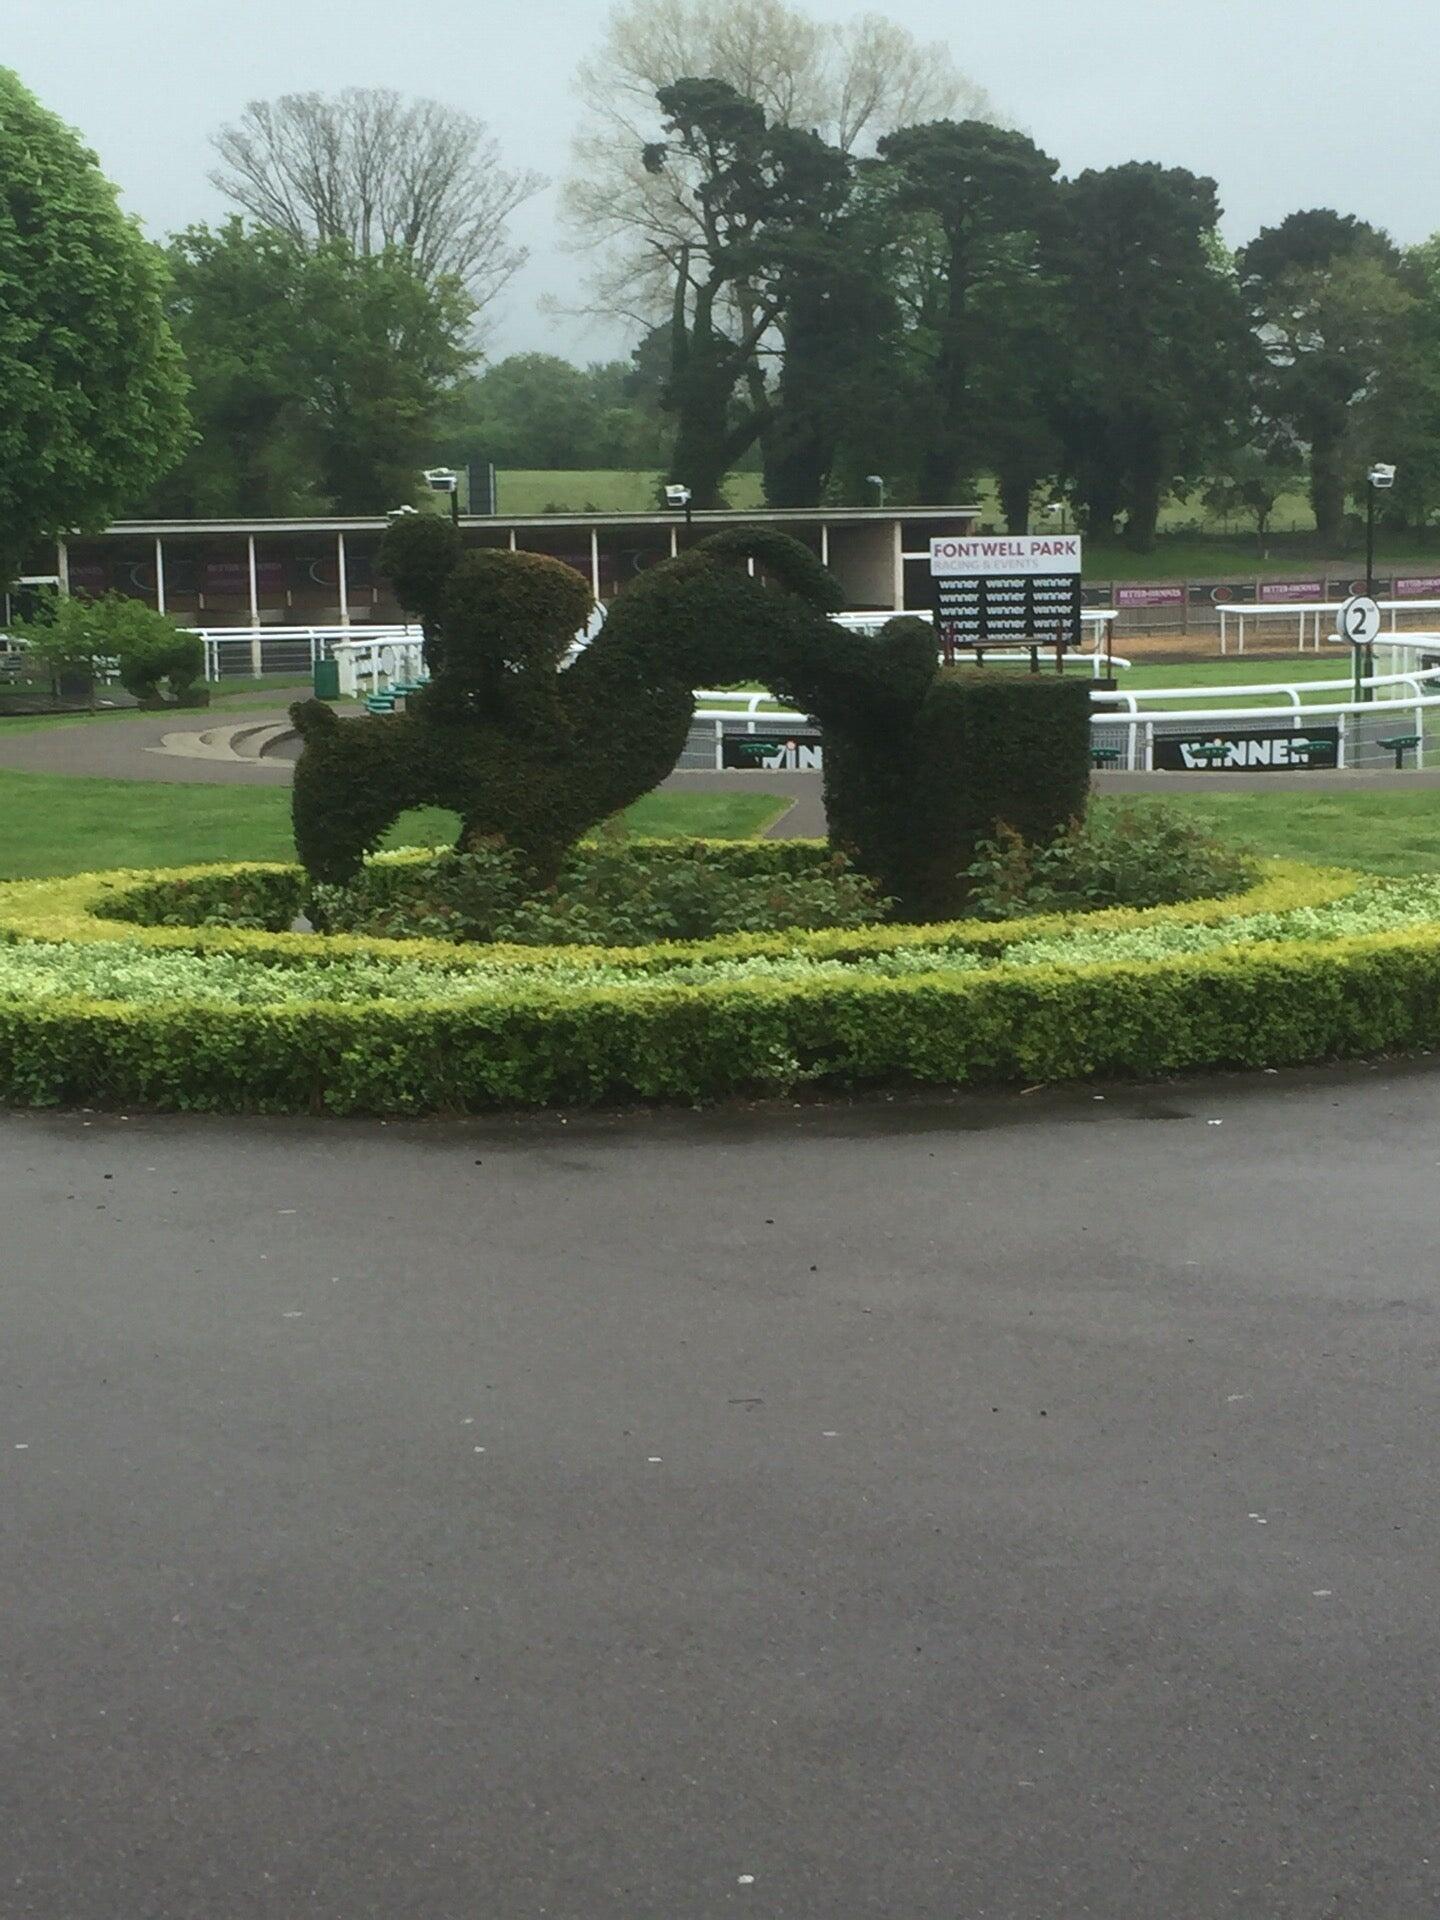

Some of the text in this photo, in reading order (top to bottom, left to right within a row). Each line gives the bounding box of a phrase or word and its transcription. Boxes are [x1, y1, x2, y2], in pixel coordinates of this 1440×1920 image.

[934, 541, 1076, 557] FONTWELL PARK
[934, 560, 979, 570] RACING
[994, 558, 1038, 569] EVENTS
